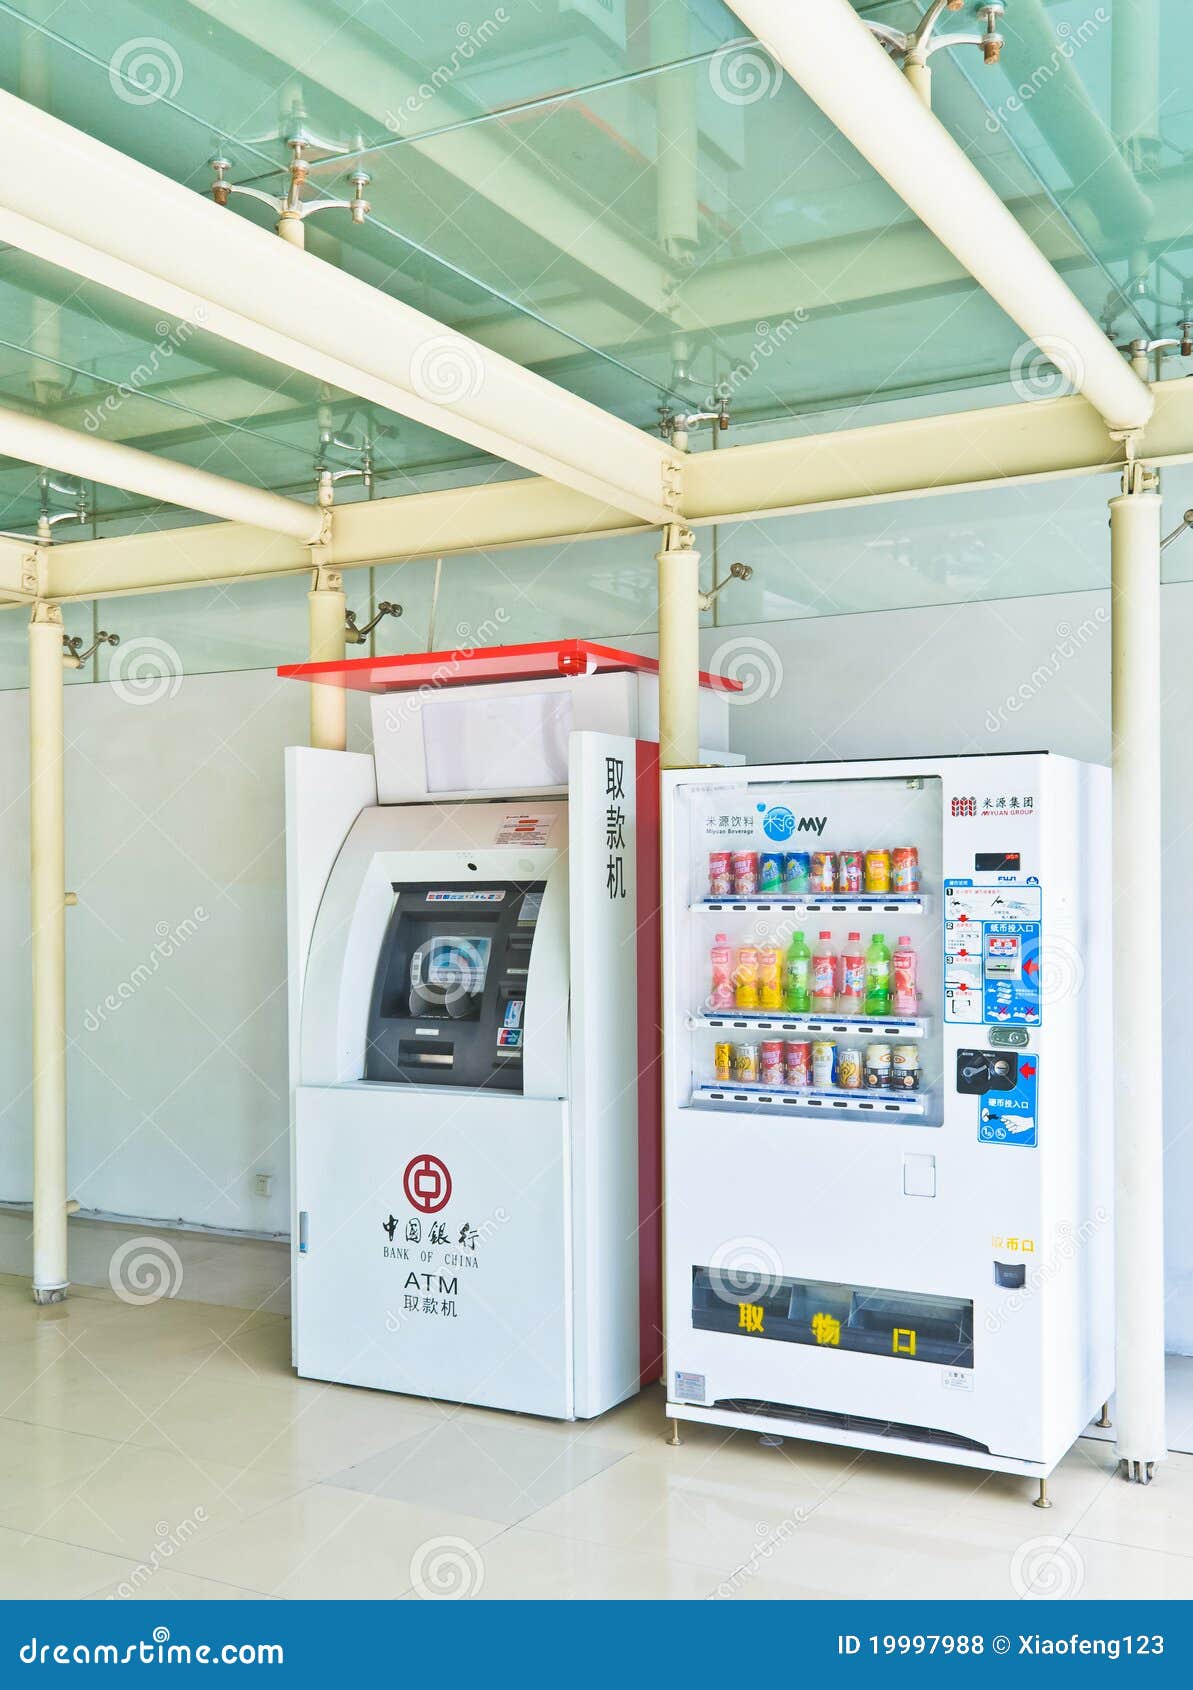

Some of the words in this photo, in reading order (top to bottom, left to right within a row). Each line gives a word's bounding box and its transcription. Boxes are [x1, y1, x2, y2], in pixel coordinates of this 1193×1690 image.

[982, 796, 1034, 809] 米源集团
[605, 757, 626, 899] 取款机
[706, 815, 754, 828] 米源饮料
[727, 828, 754, 836] Beverage
[990, 923, 1034, 933] 纸币投入口
[988, 1098, 1029, 1109] 硬币投入口
[383, 1246, 410, 1260] BANK
[420, 1251, 433, 1263] OF
[444, 1254, 479, 1268] CHINA
[404, 1271, 458, 1295] ATM
[403, 1295, 458, 1317] 取款机
